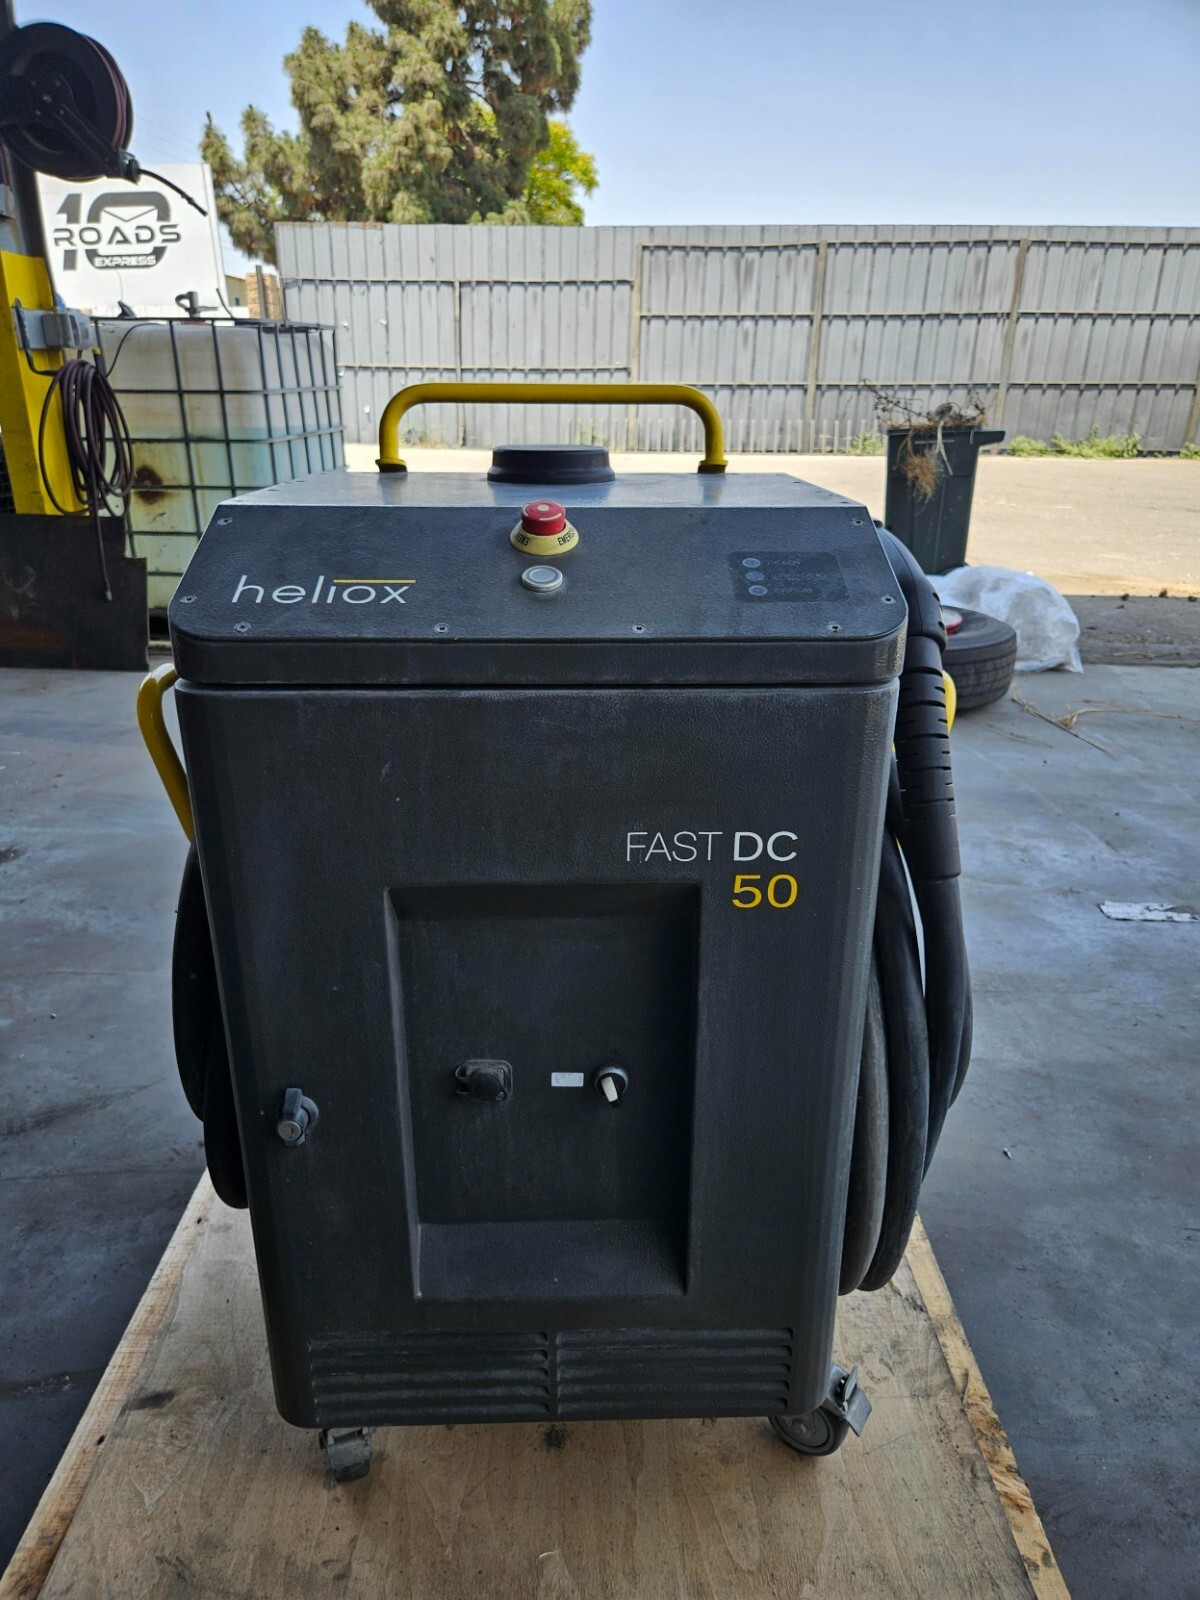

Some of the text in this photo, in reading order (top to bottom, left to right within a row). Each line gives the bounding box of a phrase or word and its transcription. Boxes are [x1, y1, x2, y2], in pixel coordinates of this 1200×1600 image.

[53, 224, 182, 246] ROADS
[57, 191, 171, 271] 10
[94, 255, 157, 267] EXPRESS
[231, 574, 410, 604] heliox
[626, 831, 799, 862] FAST DC
[732, 874, 798, 909] 50
